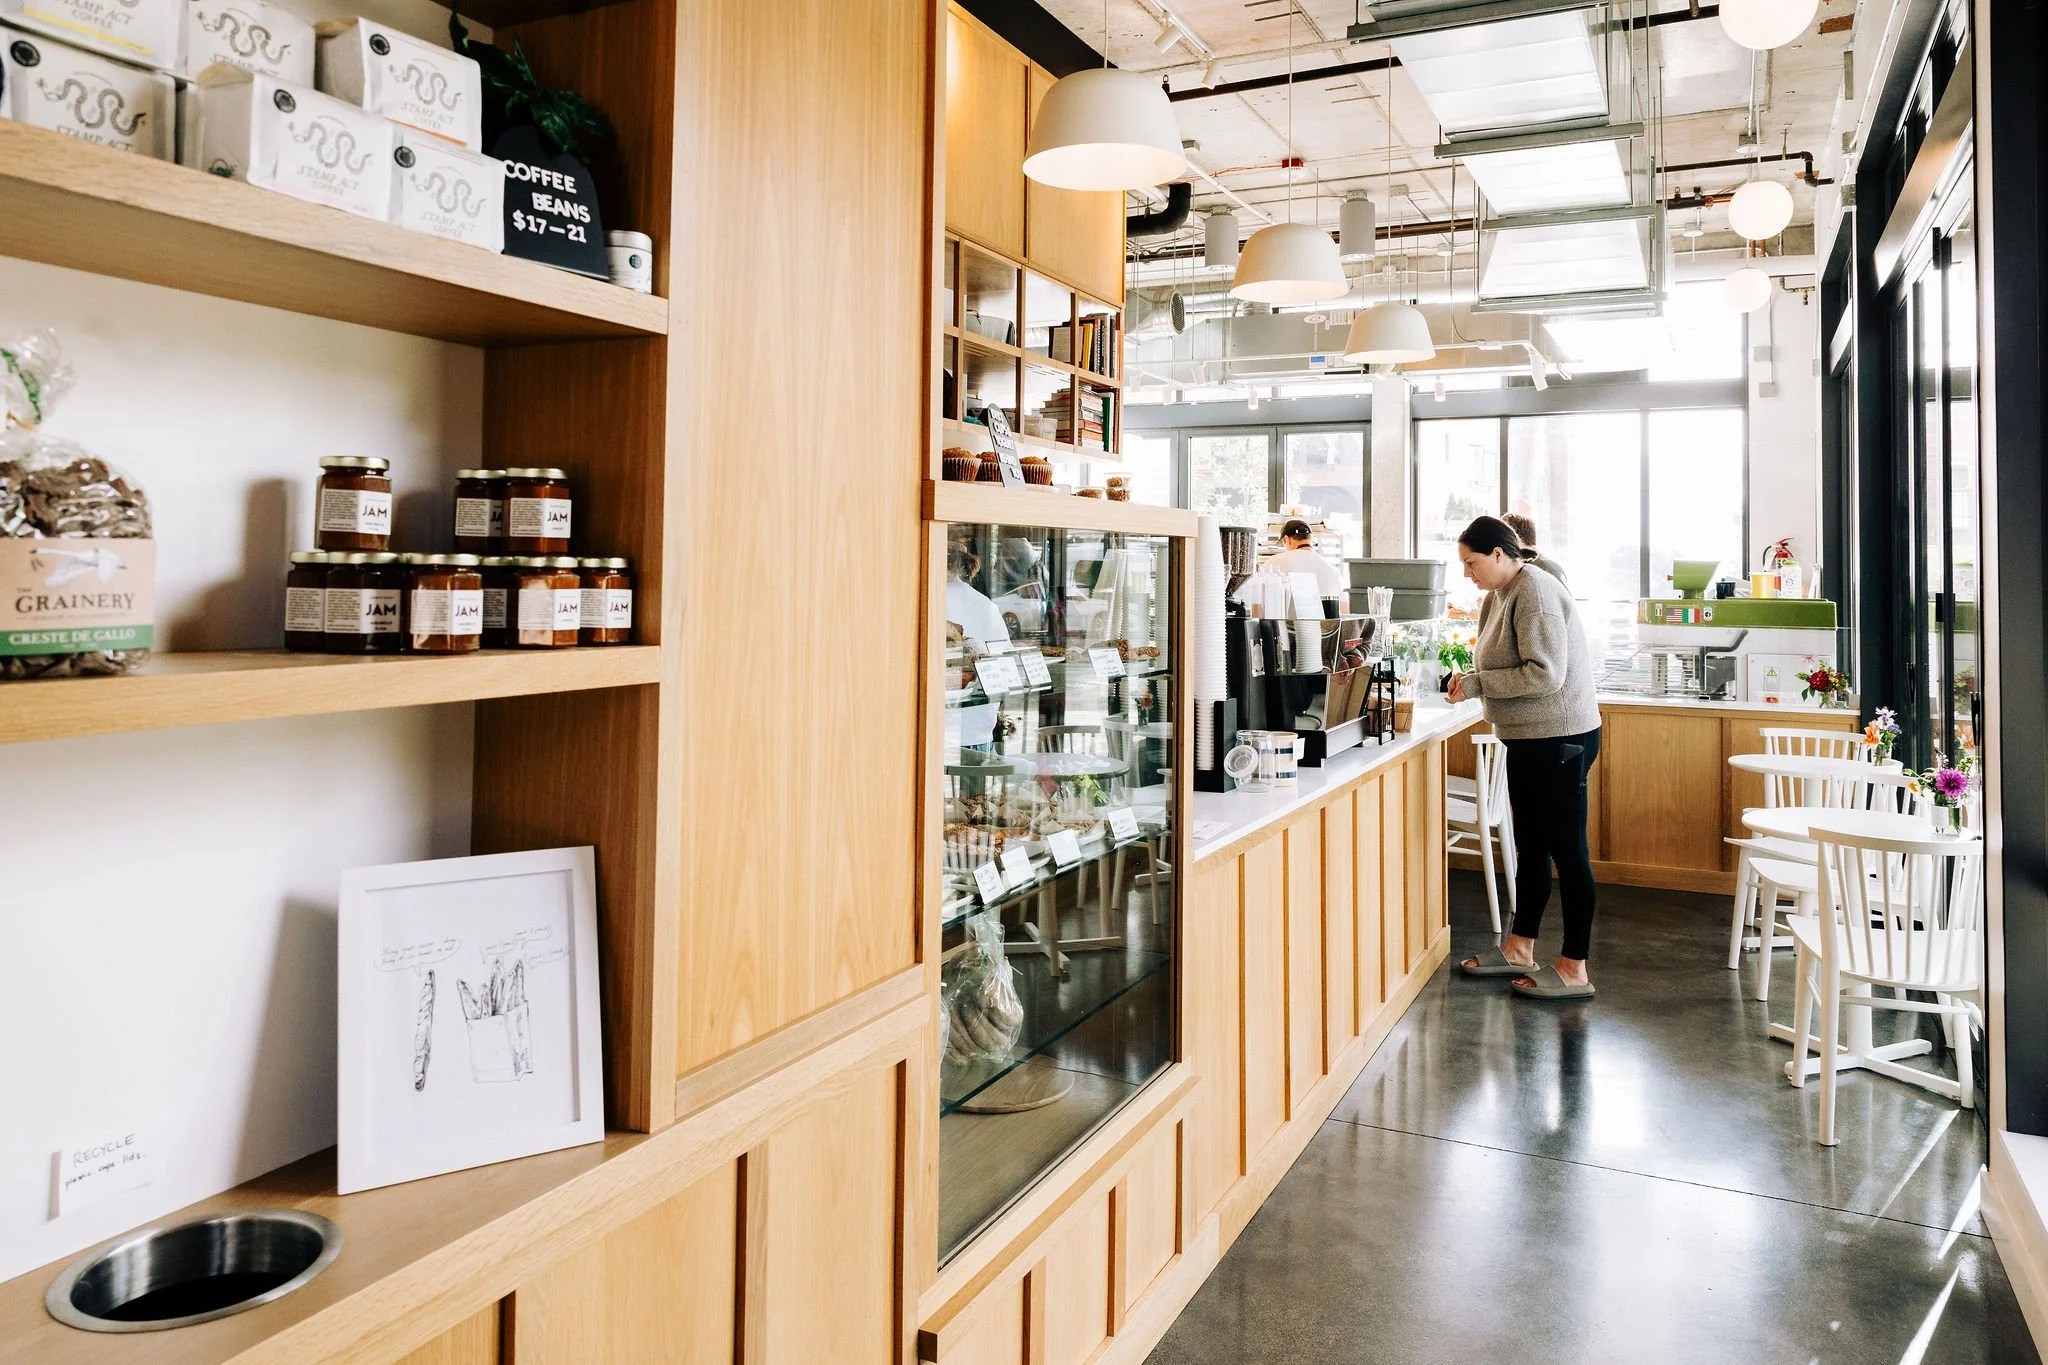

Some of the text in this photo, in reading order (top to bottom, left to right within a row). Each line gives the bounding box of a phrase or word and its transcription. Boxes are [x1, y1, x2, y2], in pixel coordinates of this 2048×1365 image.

[60, 0, 136, 24] AMP ACT
[71, 9, 113, 29] COFFEE
[503, 160, 577, 194] COFFEE
[531, 192, 591, 223] BEANS
[362, 504, 388, 518] JAM
[547, 511, 568, 523] JAM
[15, 593, 135, 614] GRAINERY
[366, 603, 397, 616] JAM
[455, 605, 479, 617] JAM
[558, 603, 578, 613] JAM
[609, 601, 629, 613] JAM
[9, 628, 136, 645] CRESTE DE GALLO
[73, 1133, 136, 1168] RECYCLE
